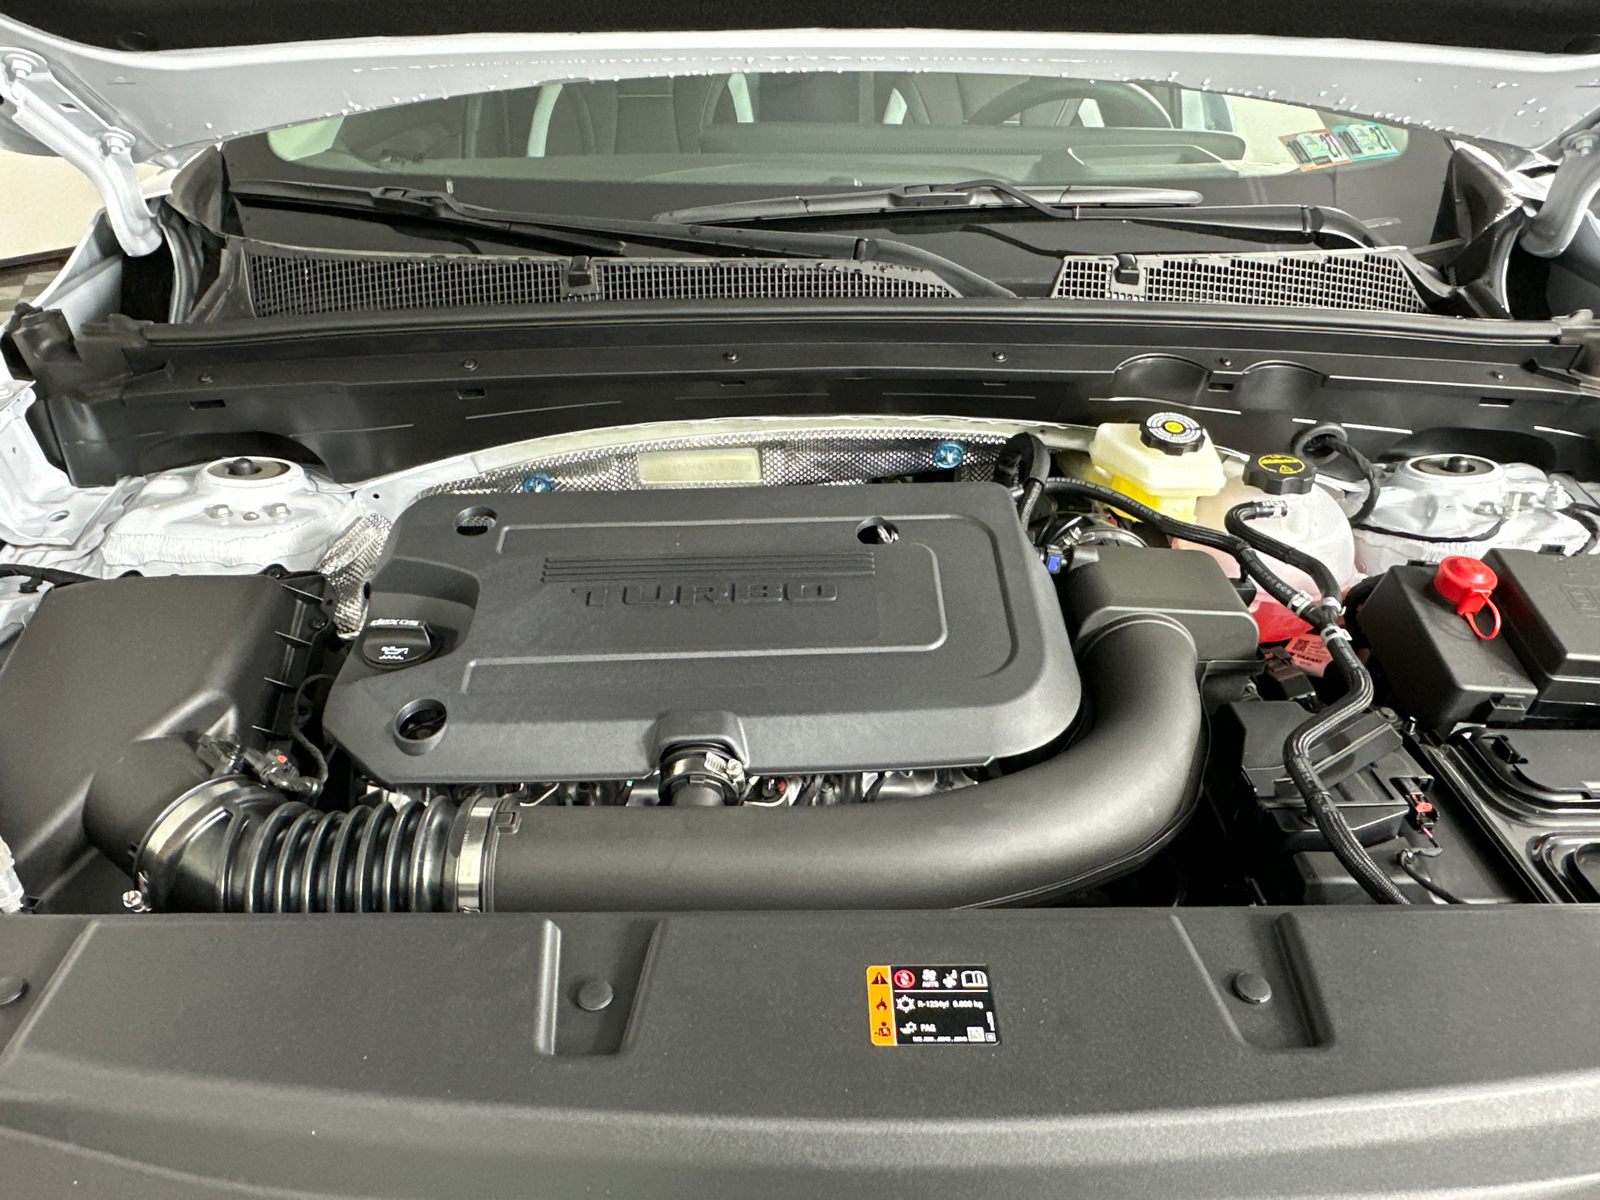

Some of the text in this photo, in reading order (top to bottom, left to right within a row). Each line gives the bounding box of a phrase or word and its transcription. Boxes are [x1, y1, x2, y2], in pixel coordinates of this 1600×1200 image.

[1368, 126, 1391, 150] 27
[1286, 133, 1342, 164] 10 27
[570, 582, 838, 607] TURBO
[922, 980, 939, 988] AUTO
[917, 1000, 949, 1009] R-1234yf
[974, 1000, 984, 1009] kg
[920, 1023, 937, 1032] PAG
